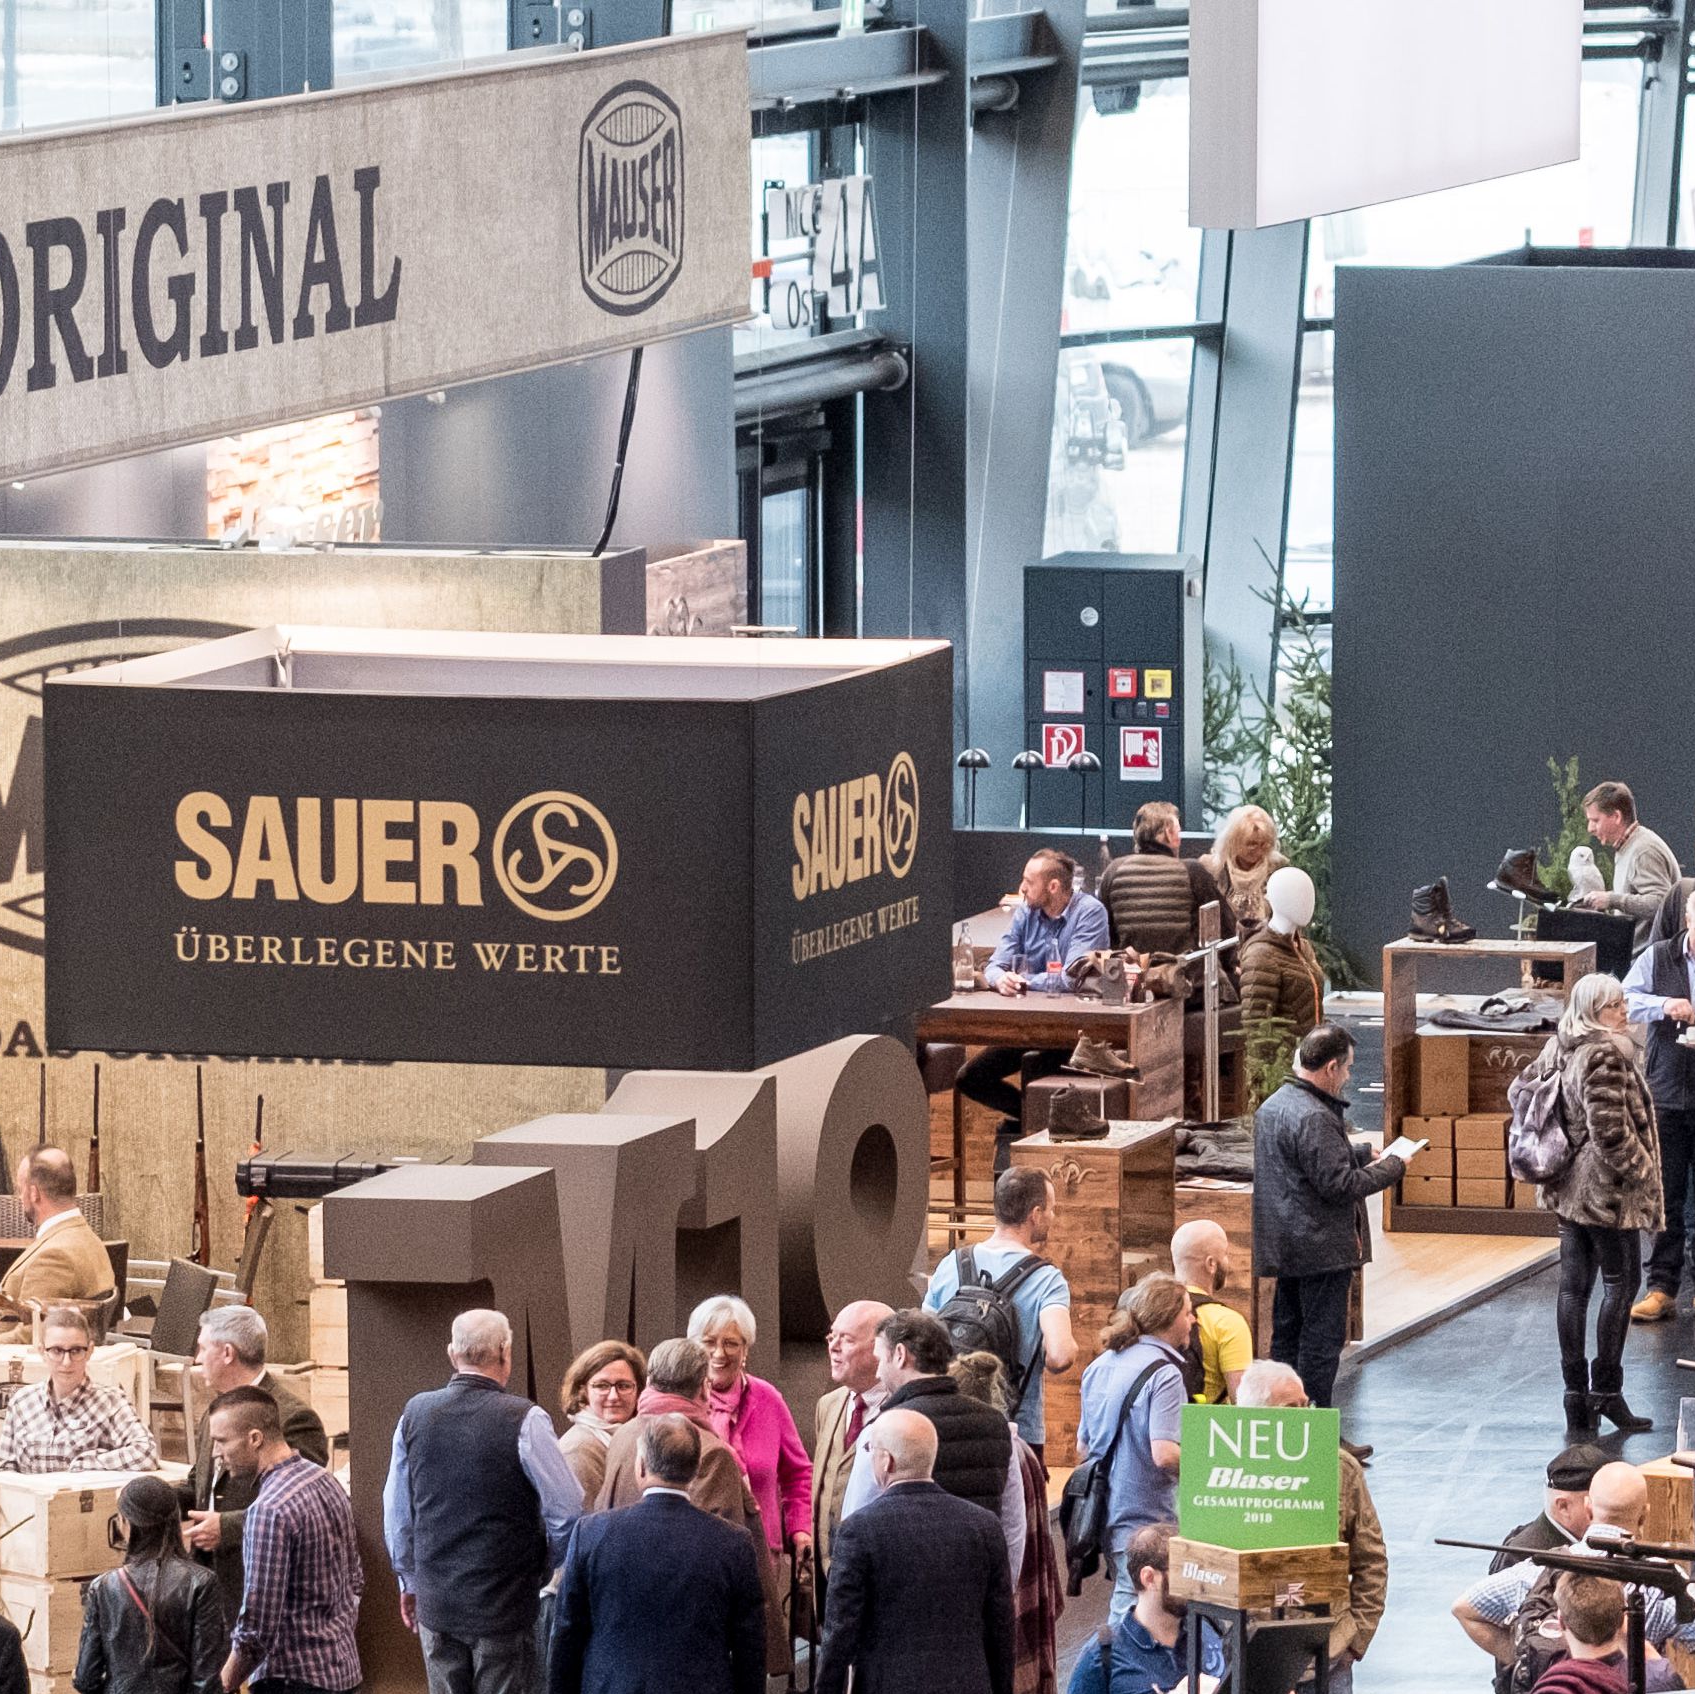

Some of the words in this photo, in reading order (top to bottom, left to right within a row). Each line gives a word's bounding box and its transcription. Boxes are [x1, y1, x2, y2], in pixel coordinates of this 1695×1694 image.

[587, 131, 676, 273] MAUSER
[174, 791, 483, 906] SAUER
[792, 773, 881, 902] SAUER
[174, 926, 457, 970] ÜBERLEGENE
[472, 941, 622, 976] WERTE
[792, 908, 873, 964] ÜBERLEGENE
[875, 896, 920, 937] WERTE
[1208, 1417, 1310, 1461] NEU
[1206, 1466, 1310, 1491] Blaser
[1192, 1495, 1325, 1510] GESAMTPROGRAMM
[1242, 1512, 1273, 1524] 2018
[1181, 1560, 1228, 1586] Blaser
